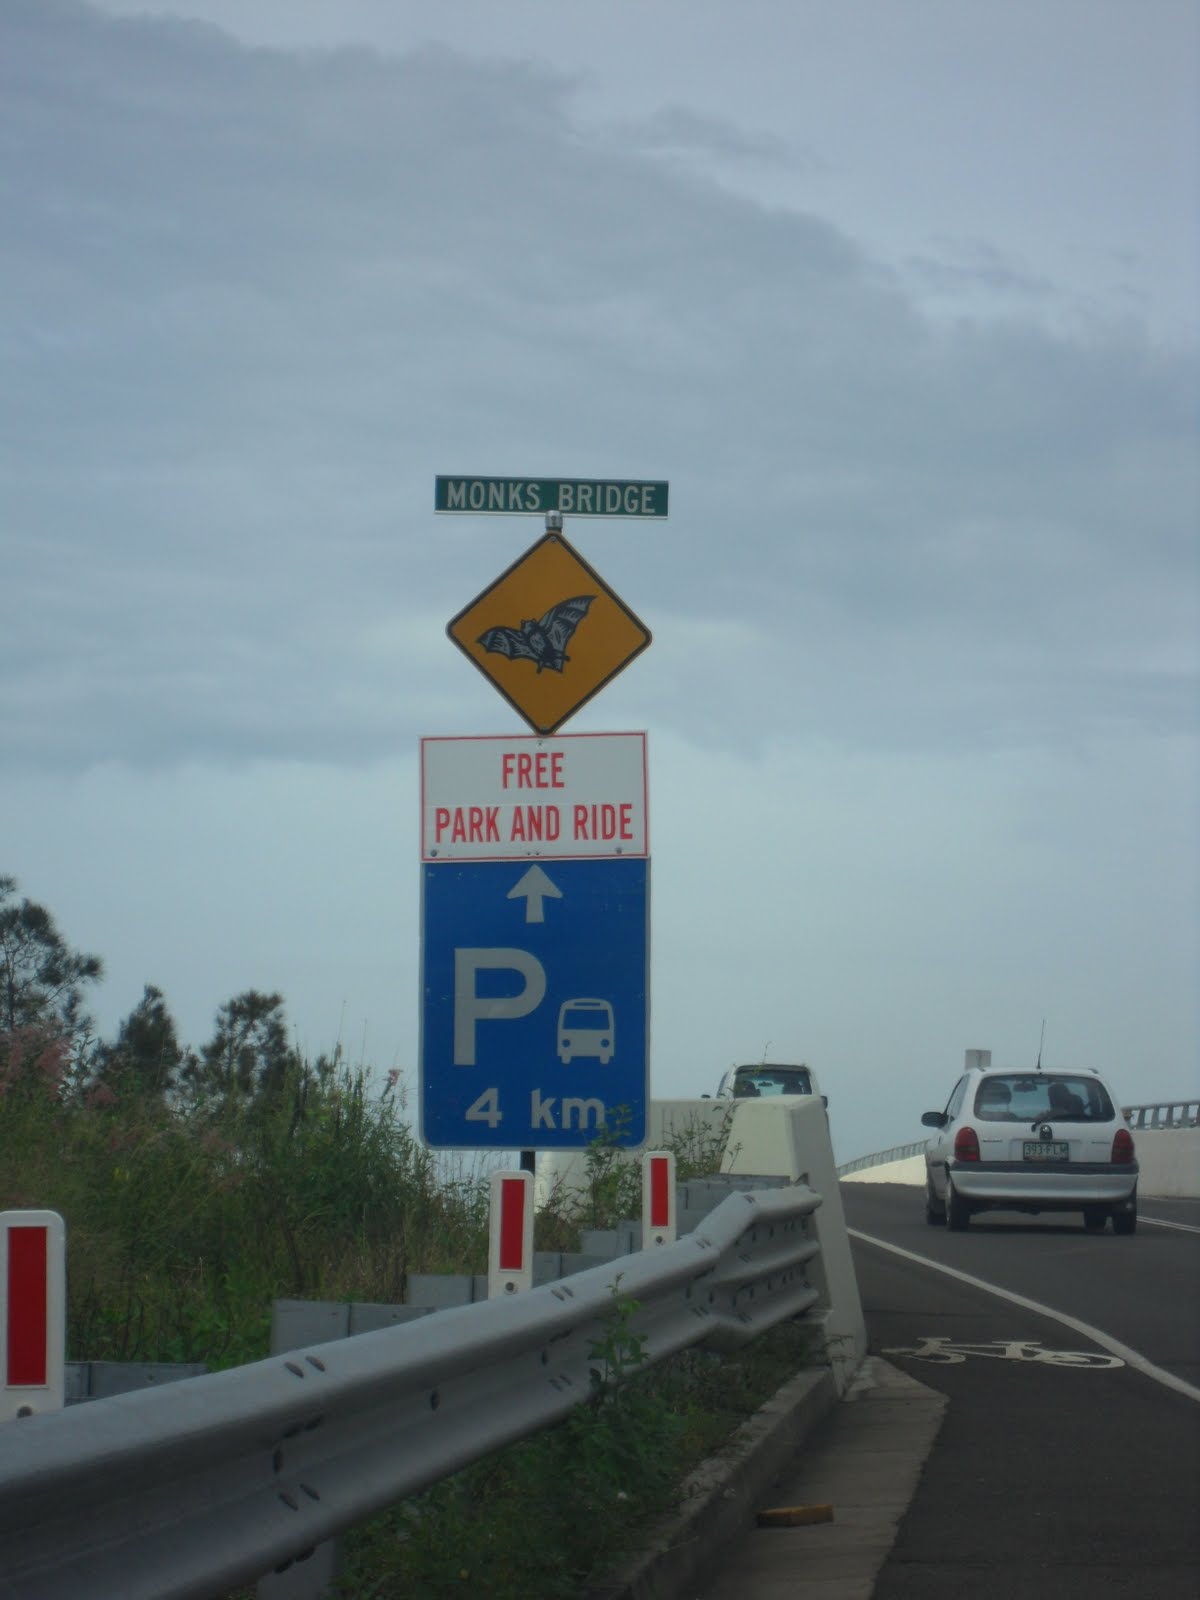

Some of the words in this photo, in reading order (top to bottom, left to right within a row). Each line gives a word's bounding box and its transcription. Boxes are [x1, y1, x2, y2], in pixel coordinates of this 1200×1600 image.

[447, 481, 541, 510] MONKS
[558, 484, 656, 514] BRIDGE
[502, 752, 565, 789] FREE
[435, 806, 501, 844] PARK
[510, 805, 561, 842] AND
[573, 803, 634, 841] RIDE
[453, 947, 547, 1066] P
[464, 1087, 503, 1128] 4
[530, 1087, 606, 1129] km
